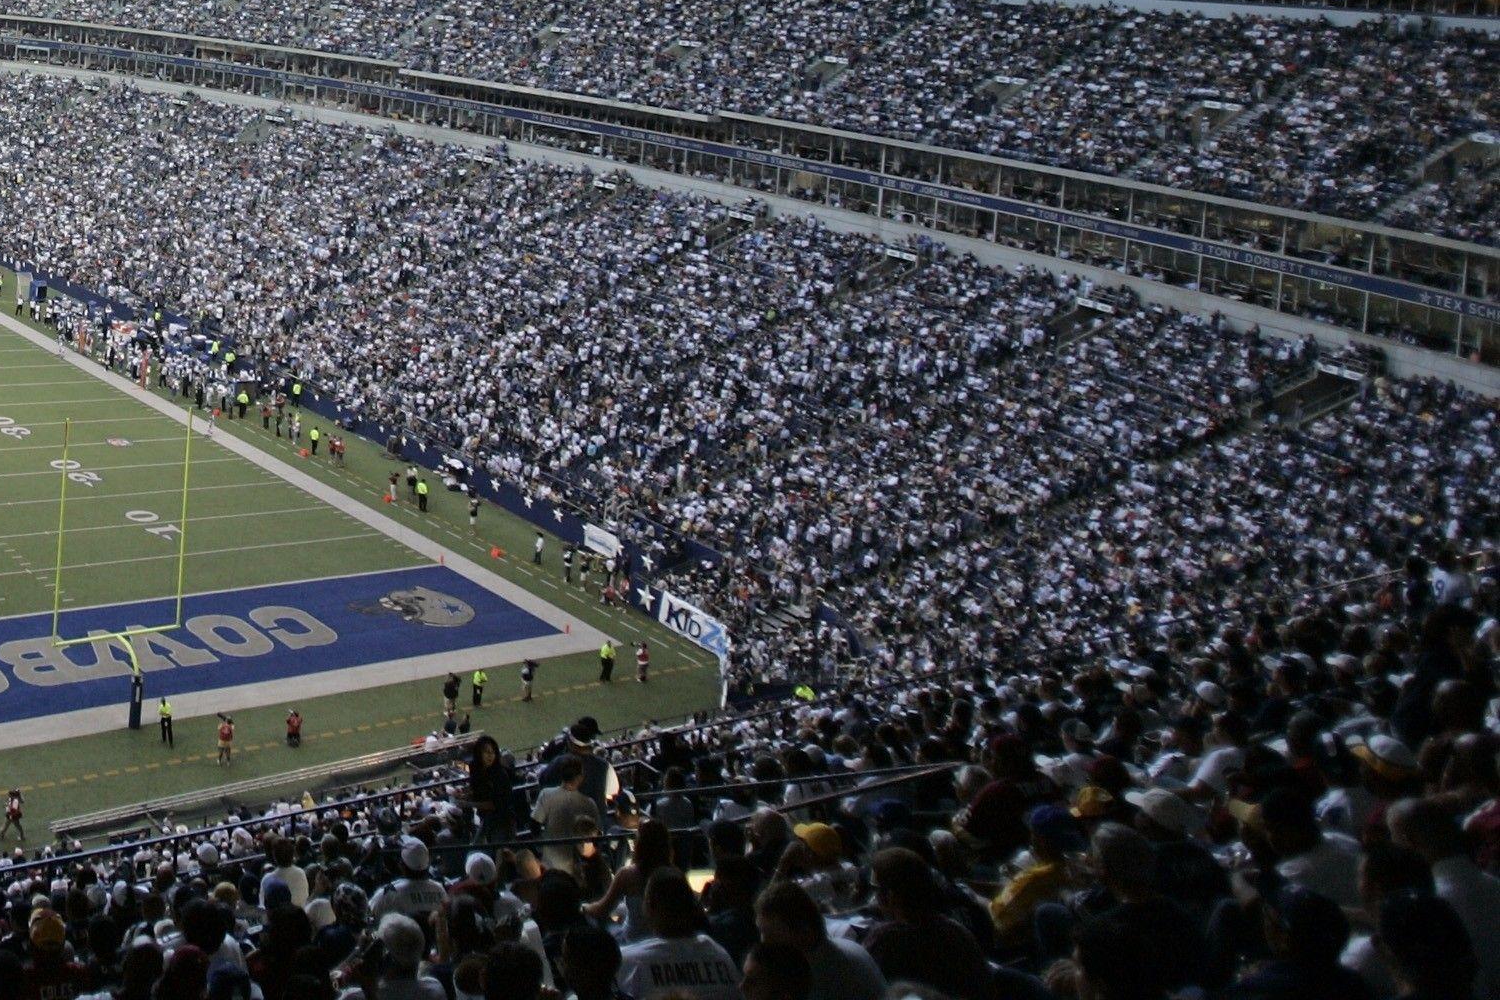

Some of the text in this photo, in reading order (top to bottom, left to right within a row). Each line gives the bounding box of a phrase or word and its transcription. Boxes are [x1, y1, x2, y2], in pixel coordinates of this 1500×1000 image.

[919, 185, 949, 198] JORDAN
[1037, 209, 1100, 230] TOM LANDRY
[1207, 245, 1239, 260] TONY
[1244, 253, 1304, 273] DORSETT
[1434, 295, 1462, 312] TEX
[50, 459, 102, 487] 20
[125, 510, 182, 540] 10
[650, 962, 717, 988] RANDLE
